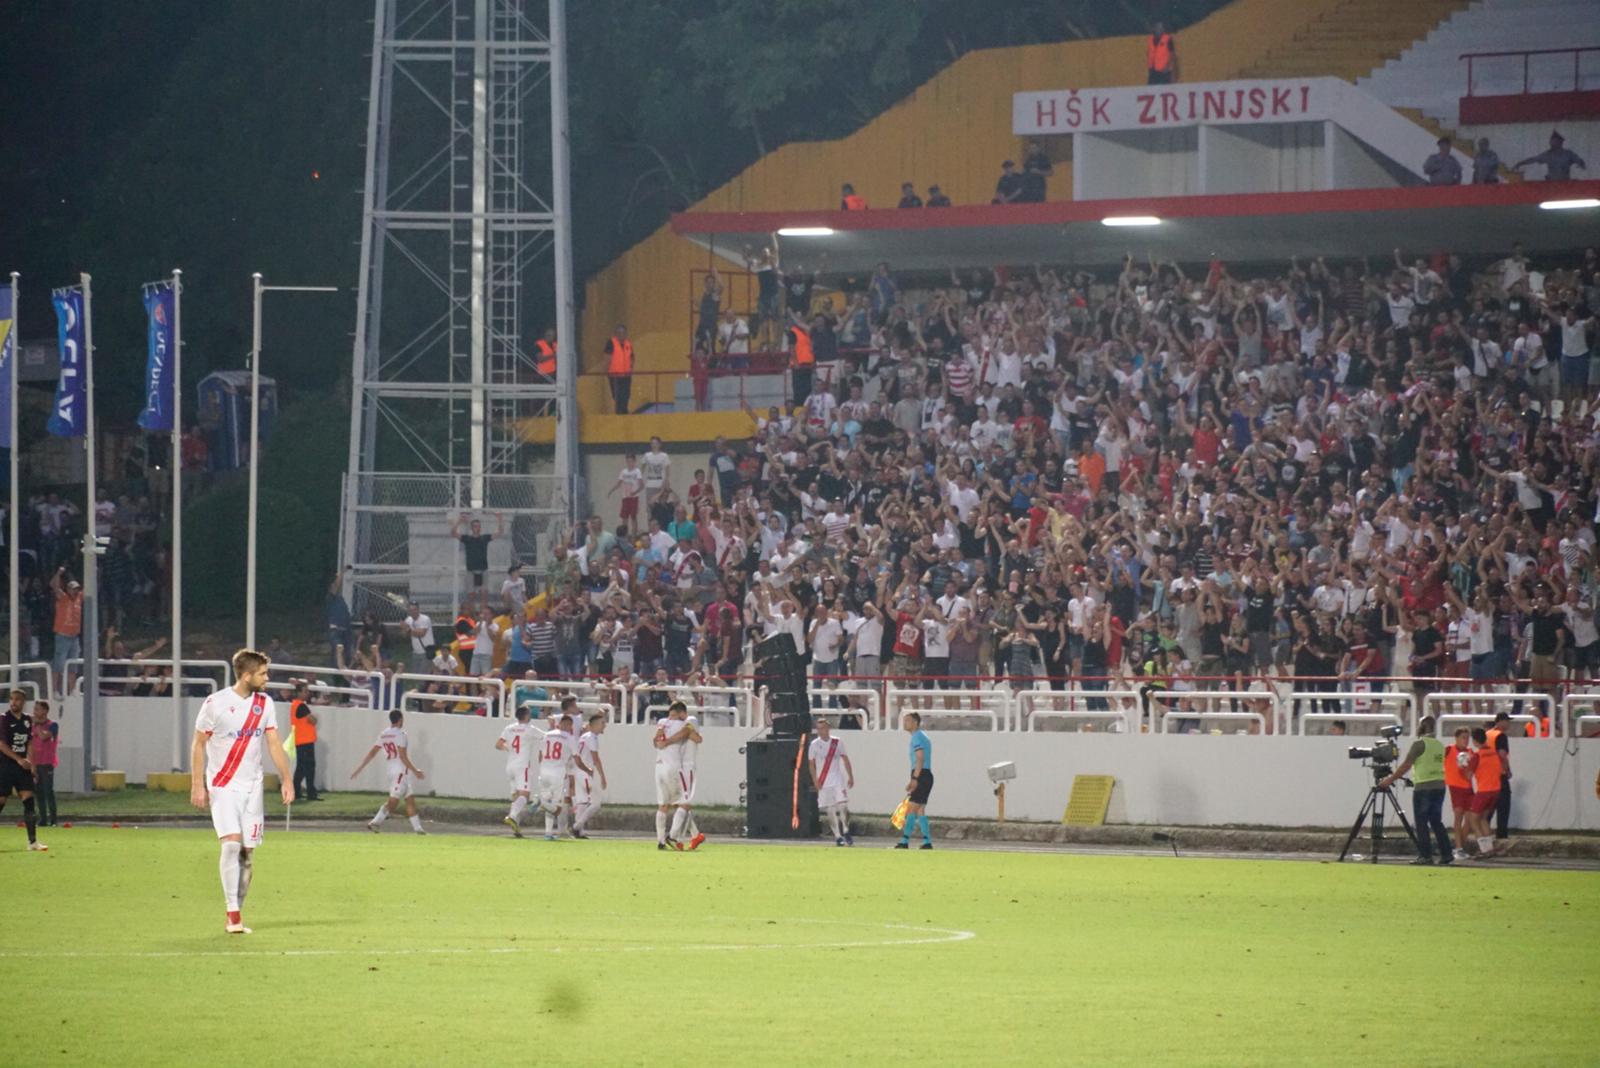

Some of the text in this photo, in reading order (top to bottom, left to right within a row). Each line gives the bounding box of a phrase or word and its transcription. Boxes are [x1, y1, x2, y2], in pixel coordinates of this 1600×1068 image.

[1036, 86, 1310, 127] HŠK ZRINJSKI
[512, 735, 521, 754] 4
[544, 740, 563, 760] 18
